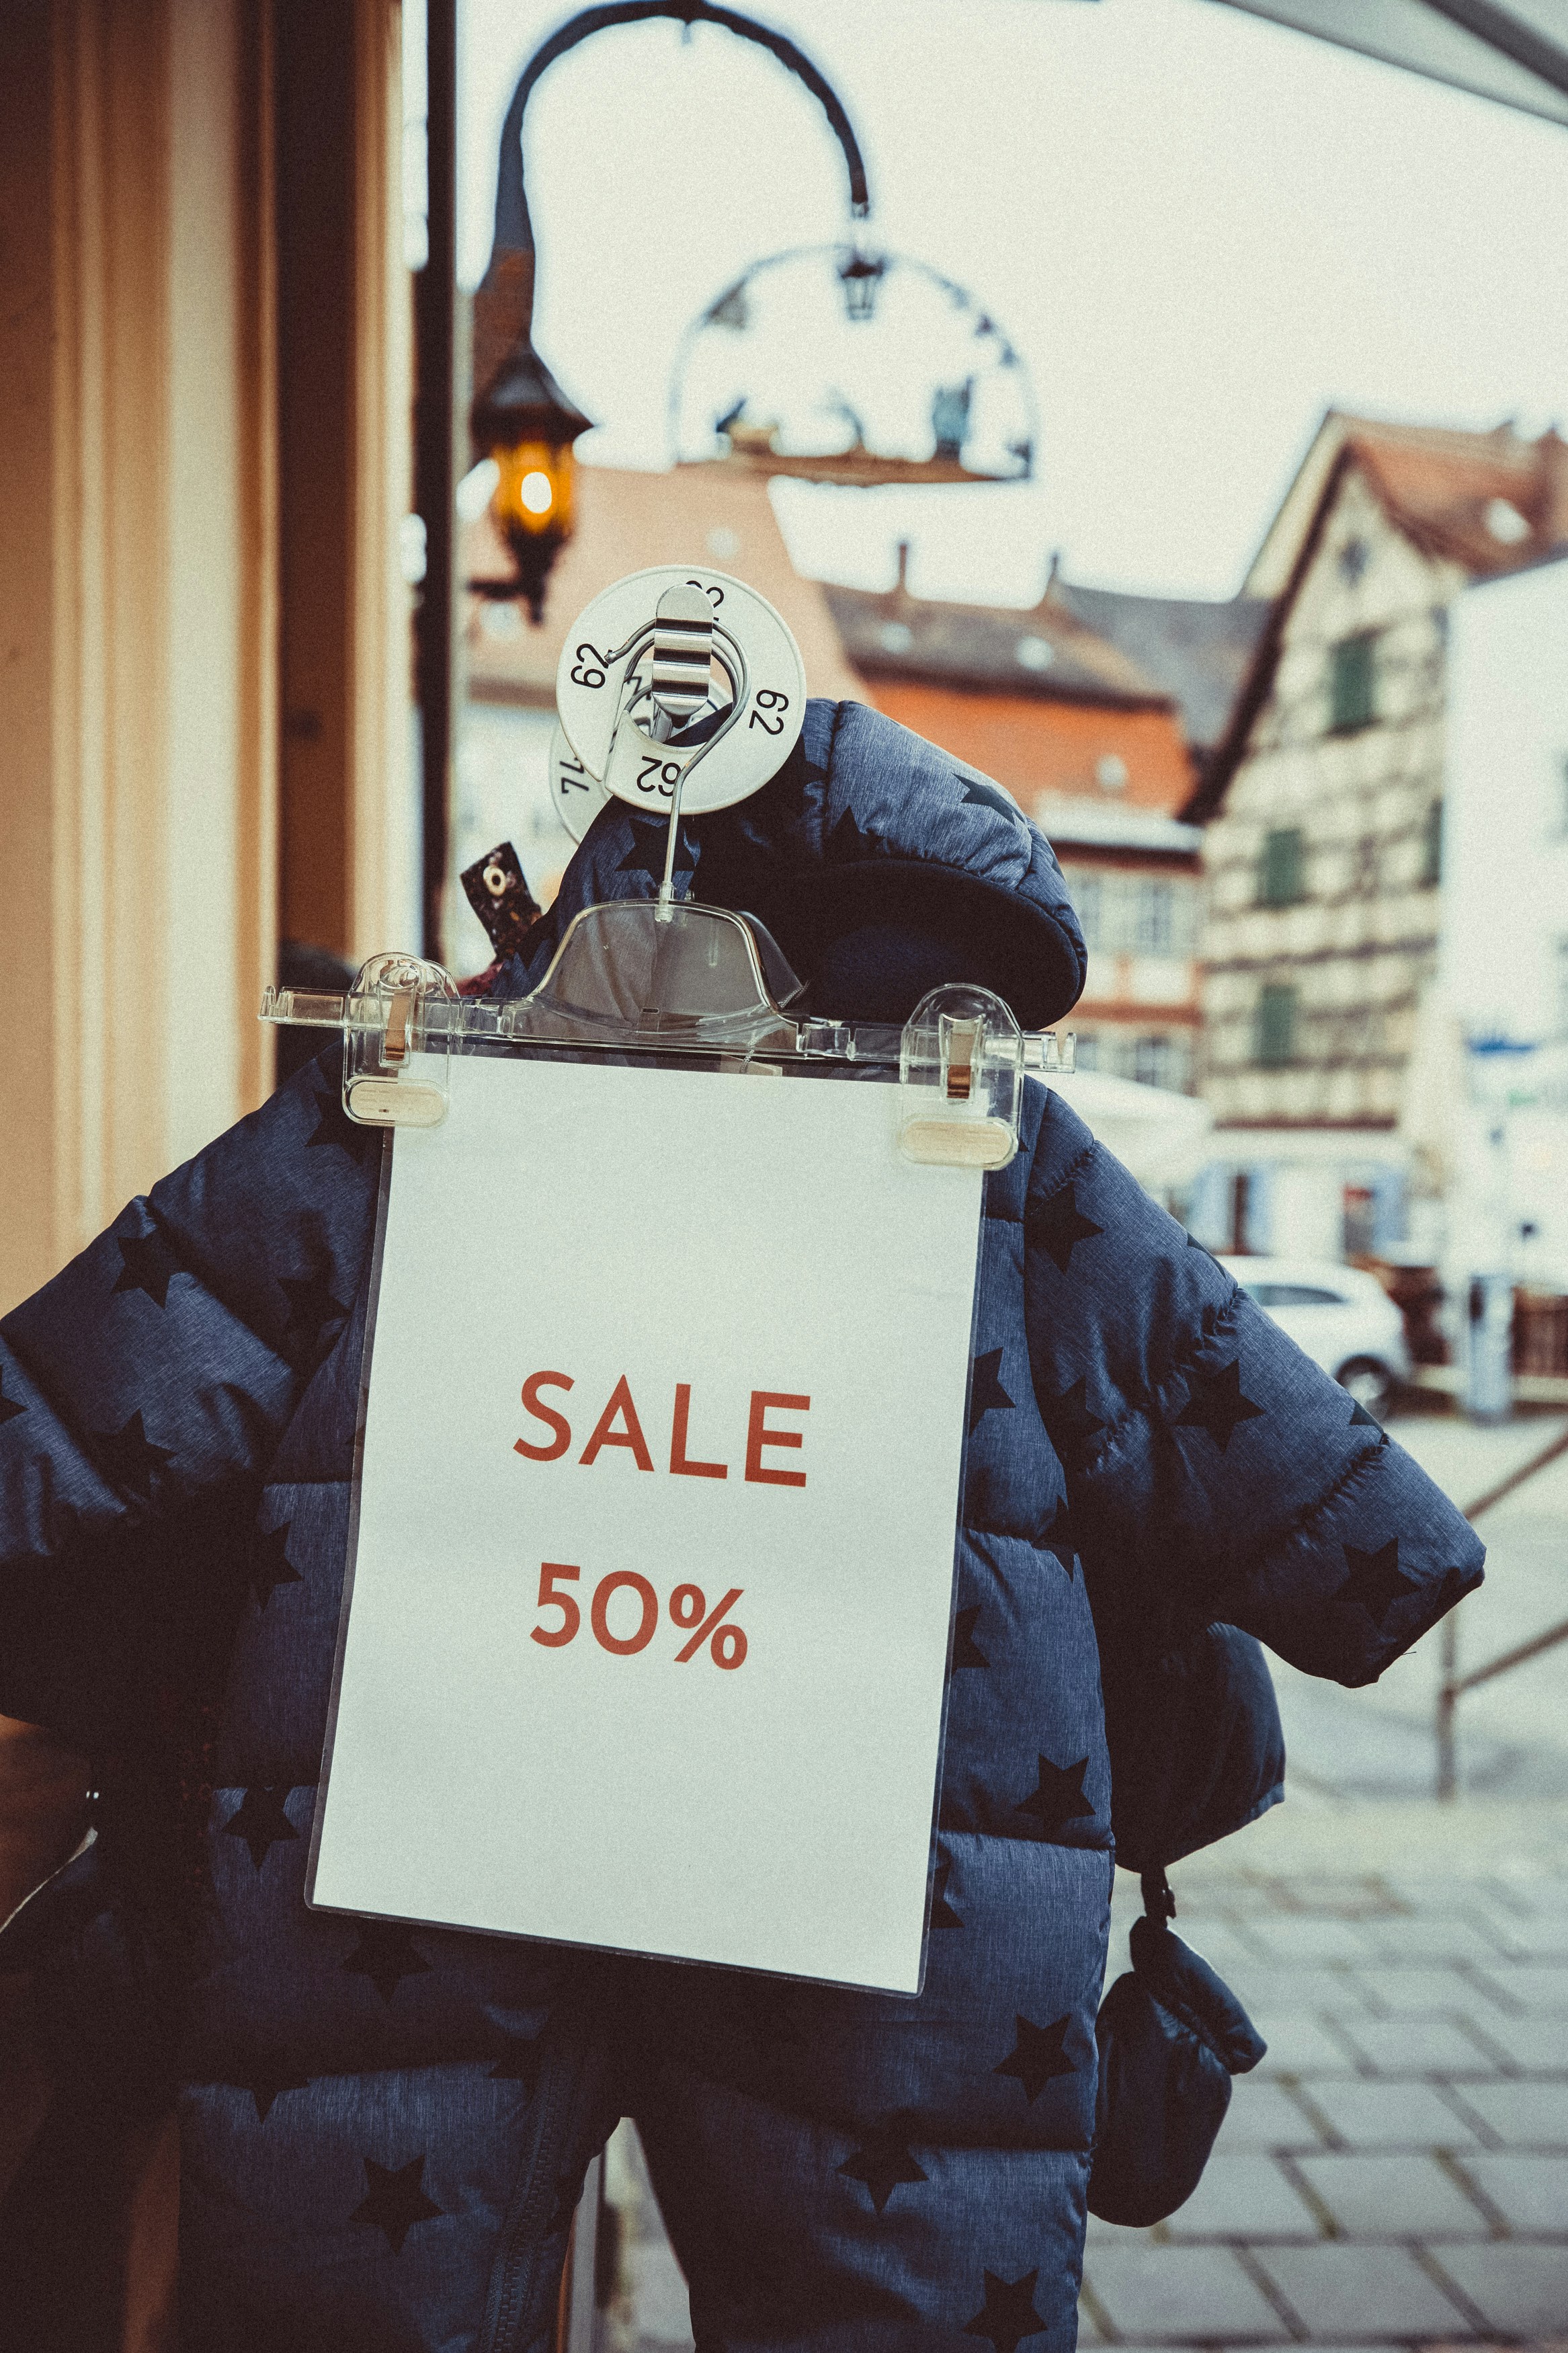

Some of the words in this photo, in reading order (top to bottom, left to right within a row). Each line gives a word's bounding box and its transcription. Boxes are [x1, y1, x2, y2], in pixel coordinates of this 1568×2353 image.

[685, 580, 725, 622] 2
[570, 643, 613, 689] 62
[749, 689, 789, 735] 62
[636, 755, 682, 797] 62
[513, 1370, 811, 1488] SALE
[530, 1562, 749, 1671] 50%
